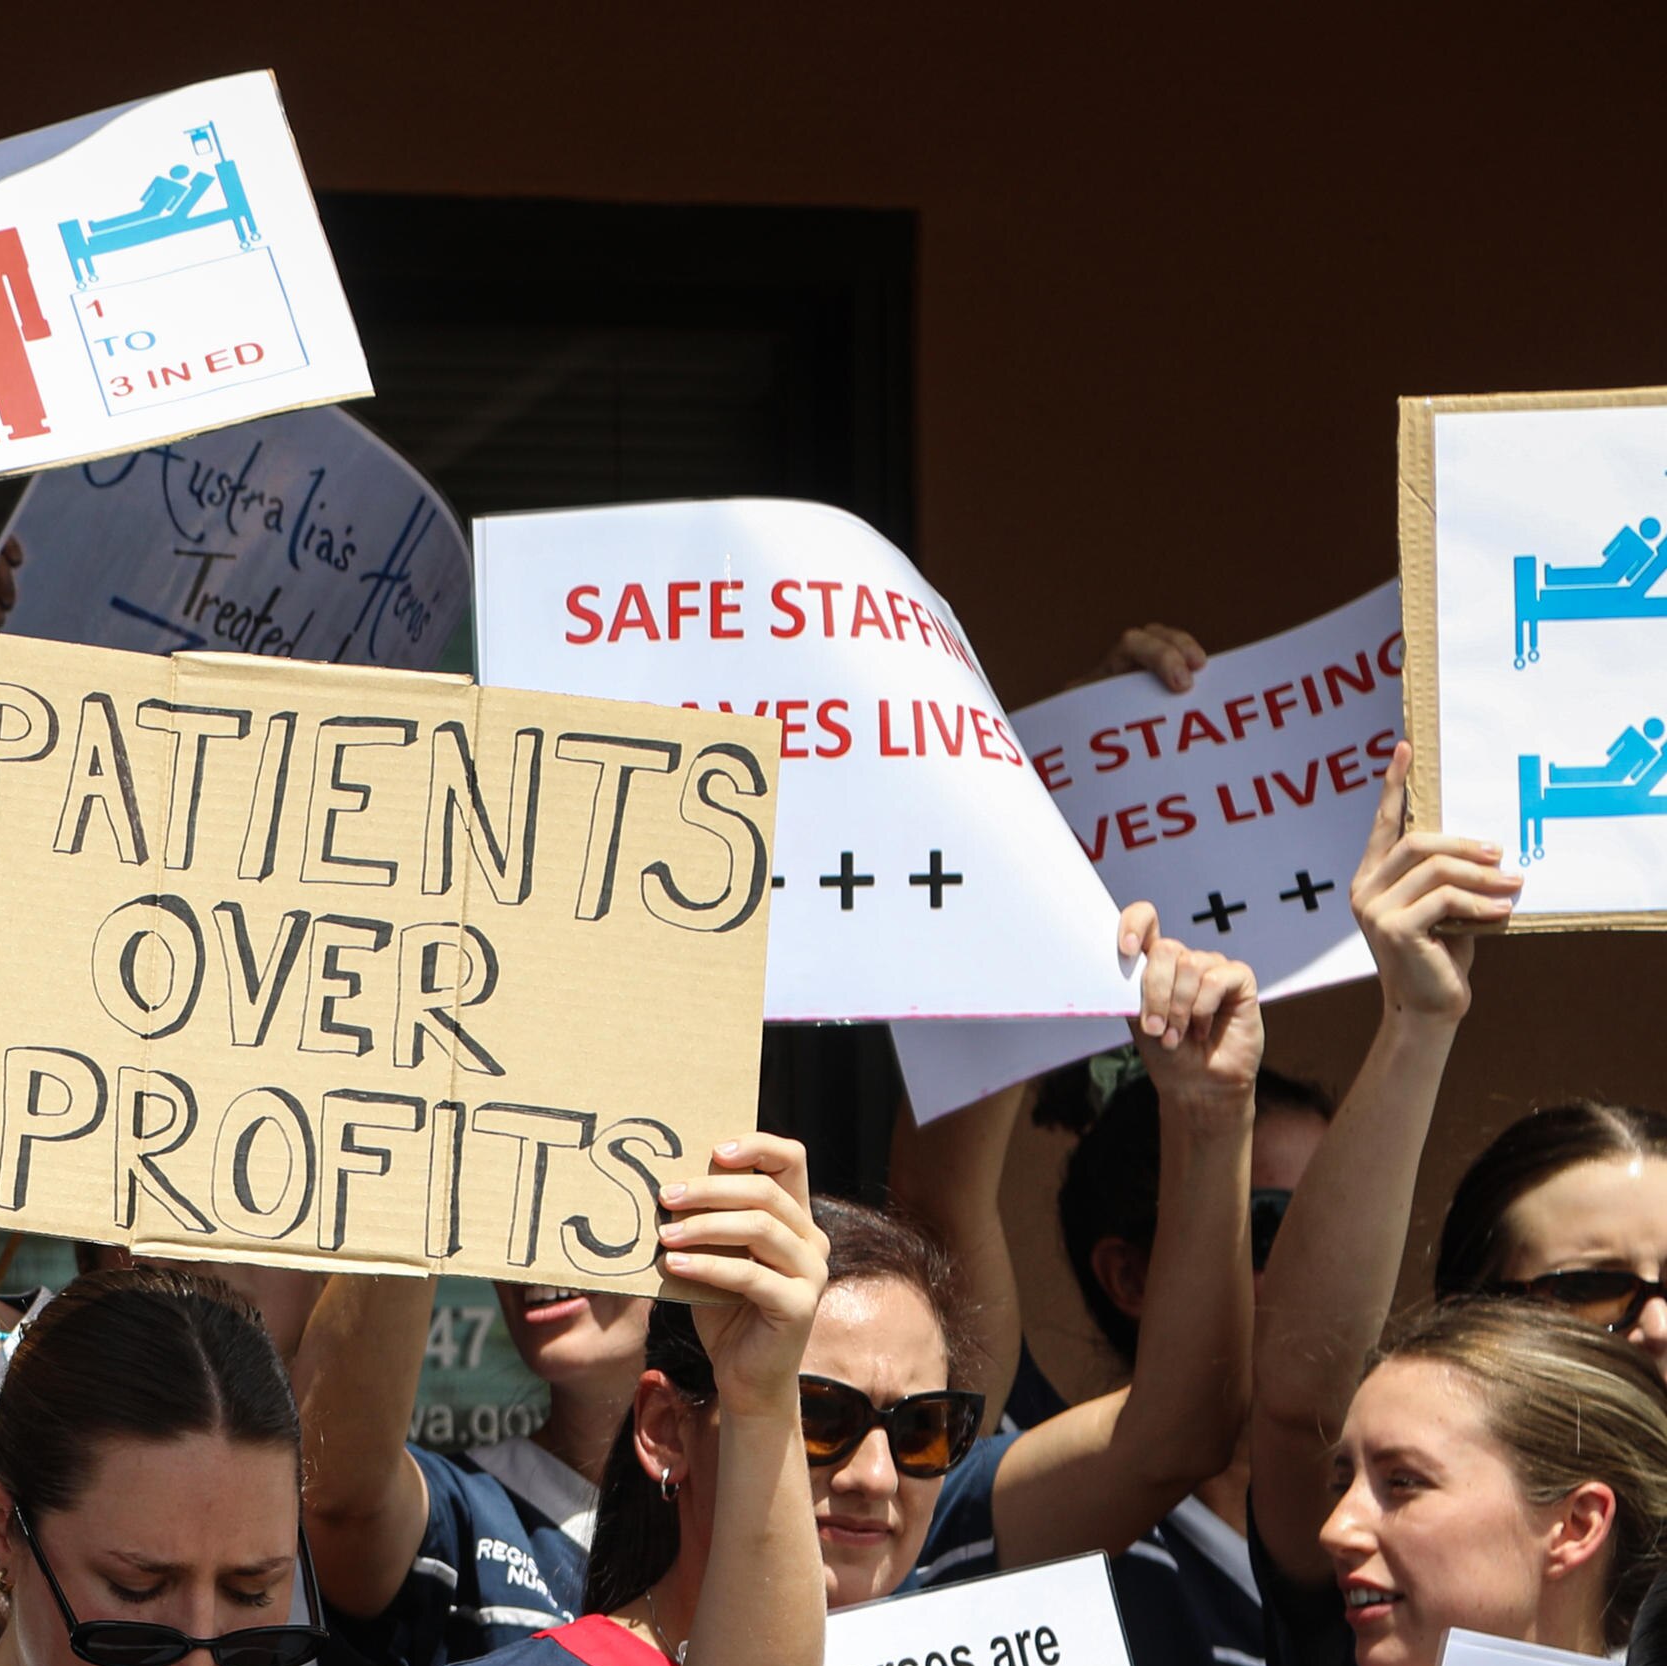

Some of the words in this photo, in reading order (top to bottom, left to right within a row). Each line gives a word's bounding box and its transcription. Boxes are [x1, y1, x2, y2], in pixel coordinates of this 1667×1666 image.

[85, 299, 105, 319] 1
[93, 329, 158, 357] TO
[110, 375, 135, 399] 3
[147, 361, 192, 389] IN
[204, 341, 267, 373] ED
[565, 580, 745, 644] SAFE
[769, 578, 974, 673] STAFFIN
[878, 698, 1024, 768] LIVES
[1075, 793, 1197, 864] VES
[1216, 729, 1396, 825] LIVES
[90, 894, 506, 1077] OVER
